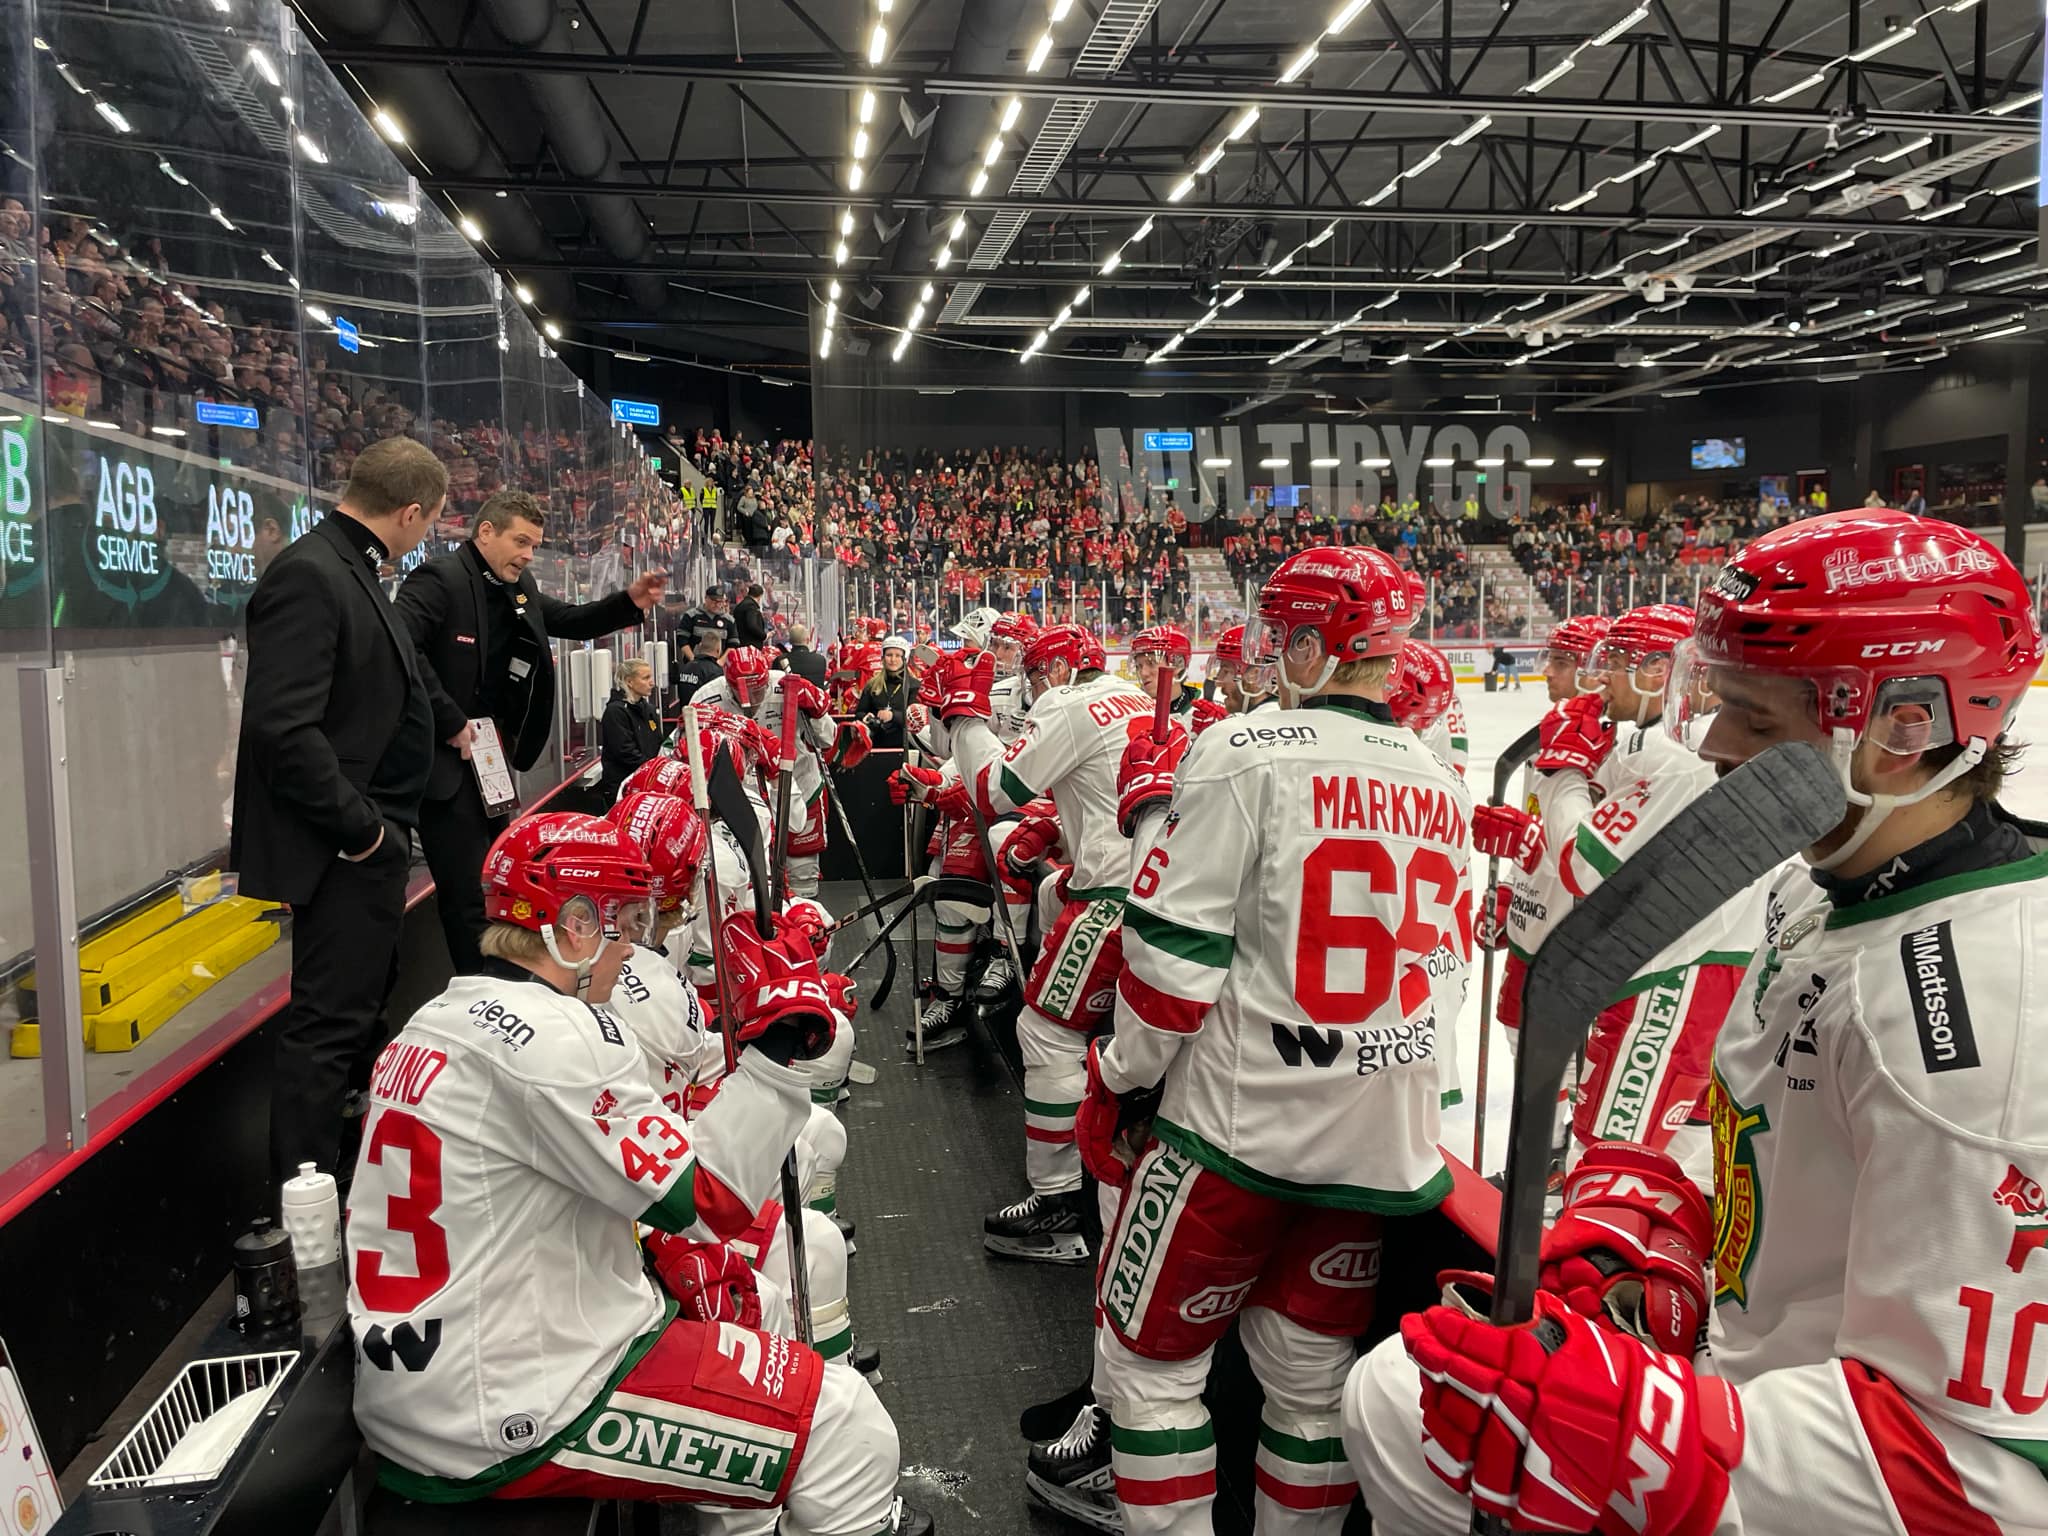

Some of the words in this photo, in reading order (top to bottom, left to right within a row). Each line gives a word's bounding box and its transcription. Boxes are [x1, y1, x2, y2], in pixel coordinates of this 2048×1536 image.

[95, 456, 158, 535] AGB
[1094, 423, 1531, 523] MULTIBYGG
[207, 484, 256, 549] AGB
[97, 534, 159, 575] SERVICE
[207, 549, 257, 582] SERVICE
[1827, 553, 1948, 591] FECTUM
[1956, 548, 1994, 573] AB
[1291, 601, 1327, 611] CCM
[1390, 589, 1406, 611] 66
[1860, 639, 1946, 659] CCM
[1229, 726, 1318, 748] clean
[1363, 734, 1408, 751] CCM
[1312, 775, 1467, 850] MARKMAN
[1591, 801, 1637, 846] 82
[559, 868, 601, 878] CCM
[1295, 837, 1460, 1024] 66
[1045, 897, 1124, 1012] RADONET
[621, 963, 651, 1003] ean
[468, 999, 536, 1046] clean
[617, 1115, 691, 1187] 43
[1723, 1175, 1751, 1269] KLUBB
[1669, 1288, 1681, 1337] CCM
[1946, 1285, 2048, 1415] 10
[585, 1411, 780, 1488] ONETT
